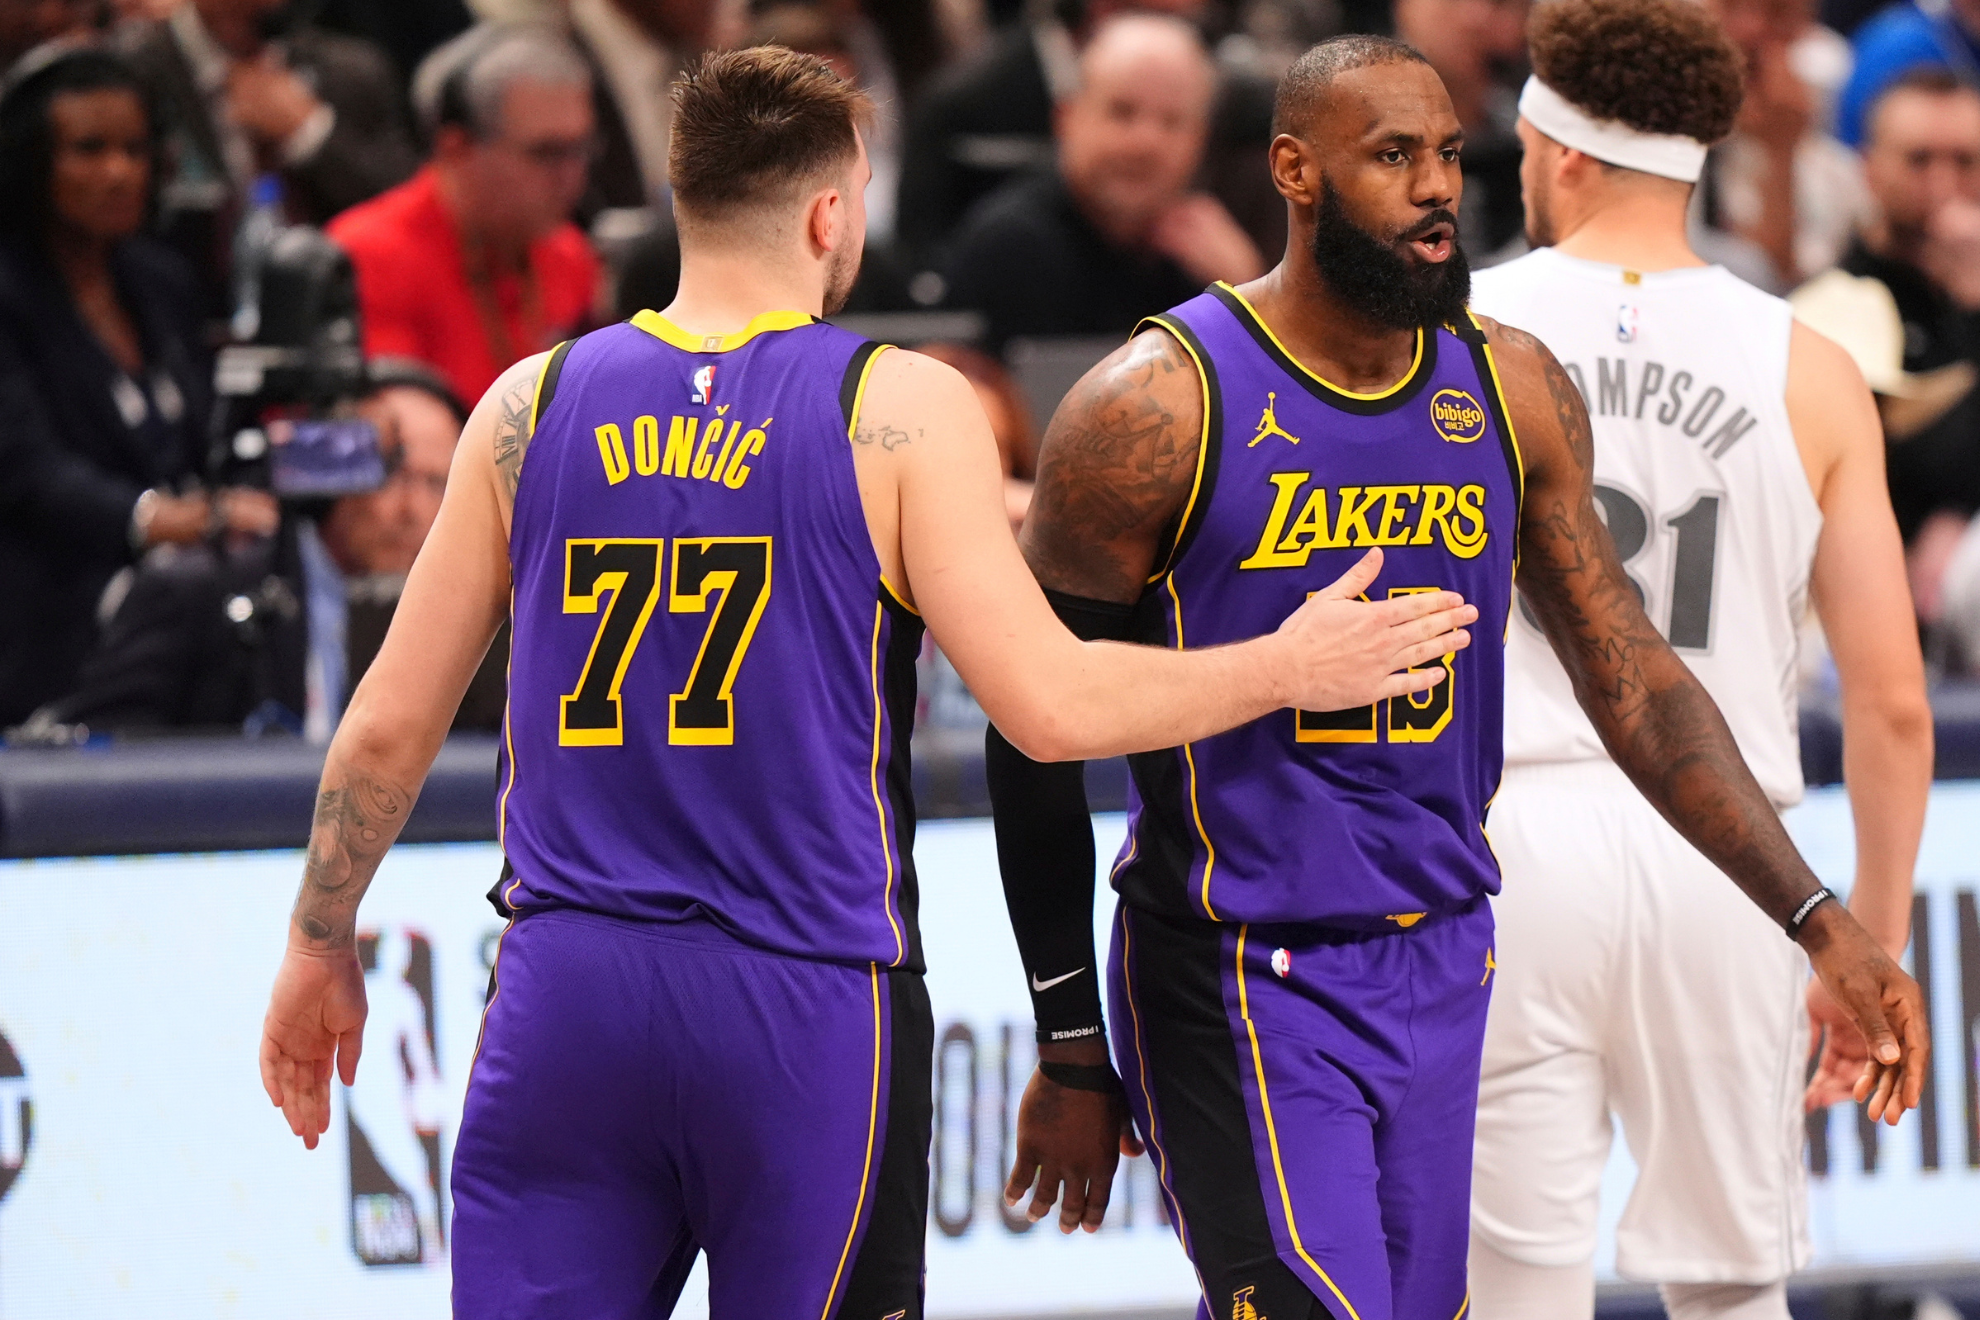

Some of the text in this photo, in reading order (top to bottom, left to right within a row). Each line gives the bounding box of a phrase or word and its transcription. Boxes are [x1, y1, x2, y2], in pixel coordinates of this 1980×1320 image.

[1435, 402, 1481, 428] bibigo
[594, 404, 773, 490] DONČIĆ
[1239, 471, 1489, 569] LAKERS
[558, 535, 773, 746] 77
[1792, 891, 1825, 925] PROMISE
[1051, 1026, 1095, 1040] PROMISE
